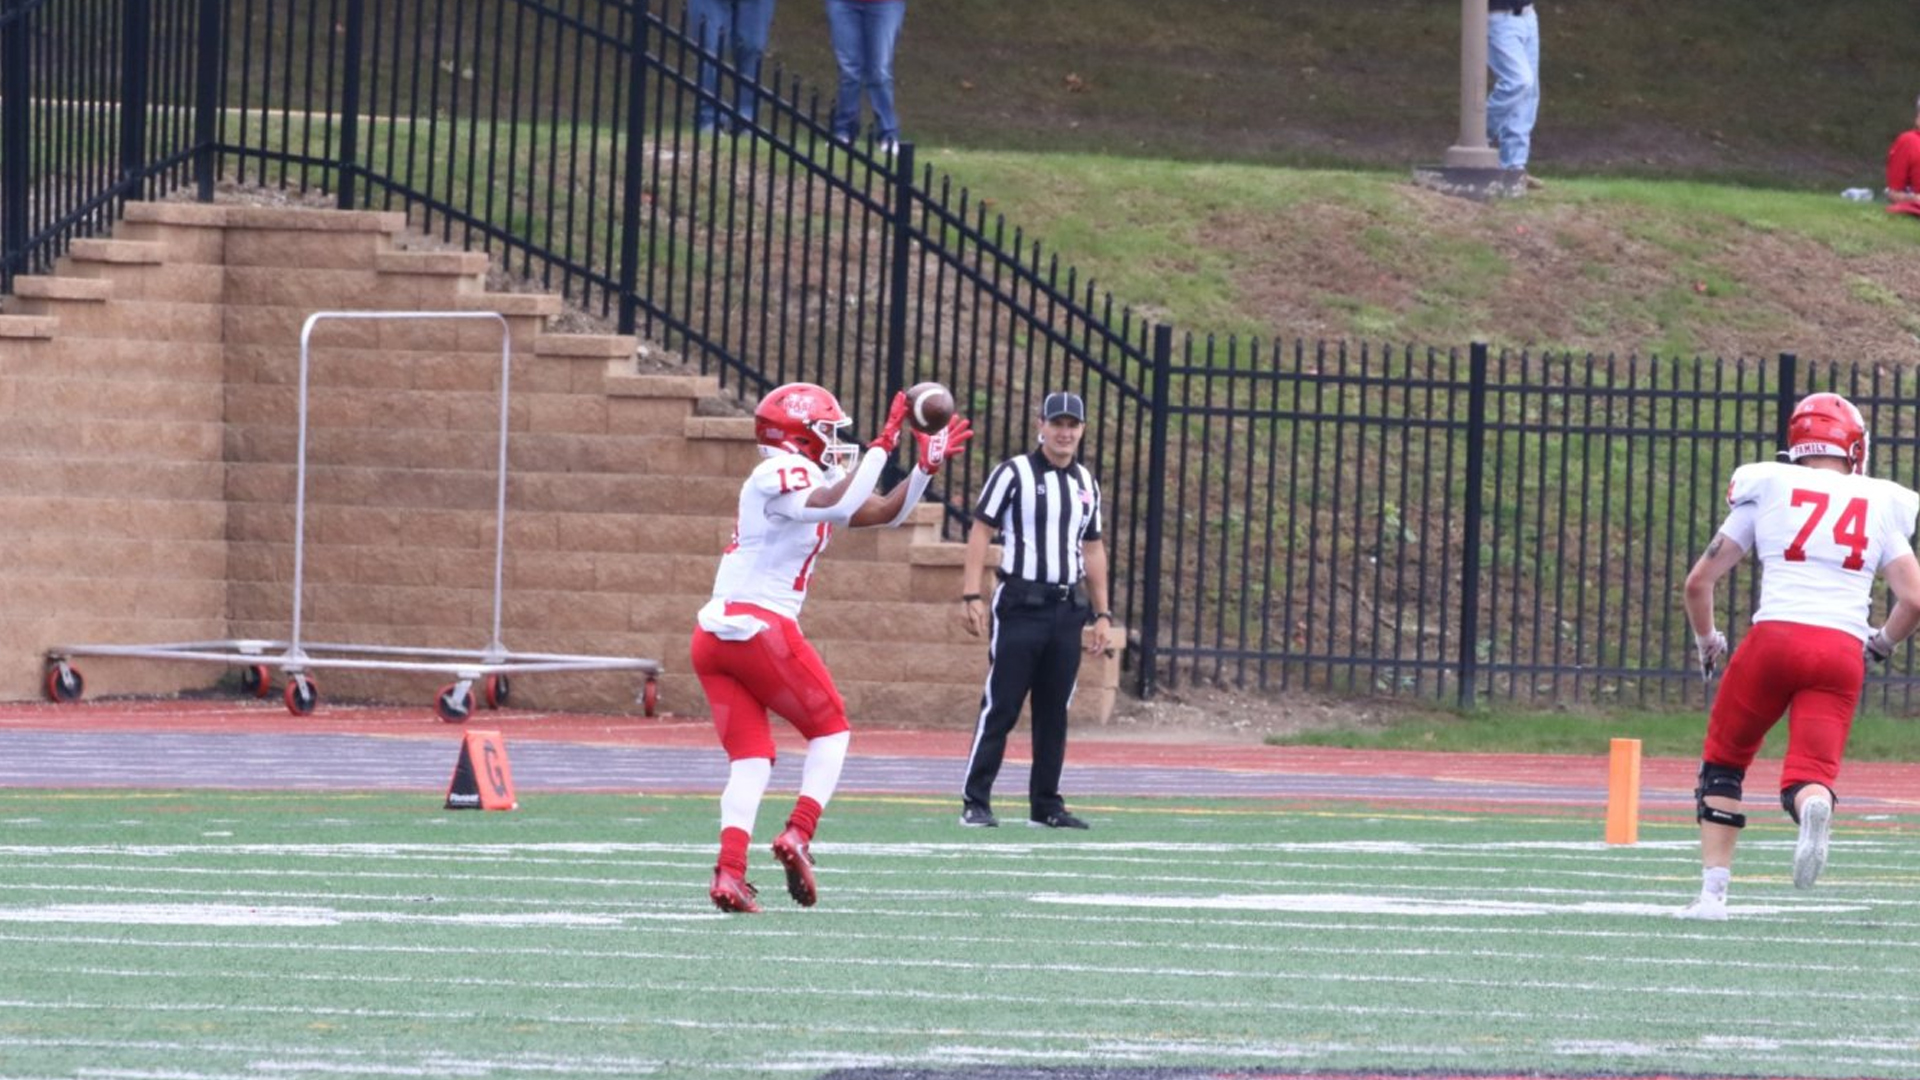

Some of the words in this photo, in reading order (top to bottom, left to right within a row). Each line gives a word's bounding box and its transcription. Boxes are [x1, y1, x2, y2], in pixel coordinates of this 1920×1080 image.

[1794, 443, 1827, 455] FAMILY
[777, 466, 812, 494] 13
[1037, 485, 1046, 495] S
[1784, 488, 1869, 571] 74
[793, 521, 832, 591] 1
[484, 739, 509, 798] G
